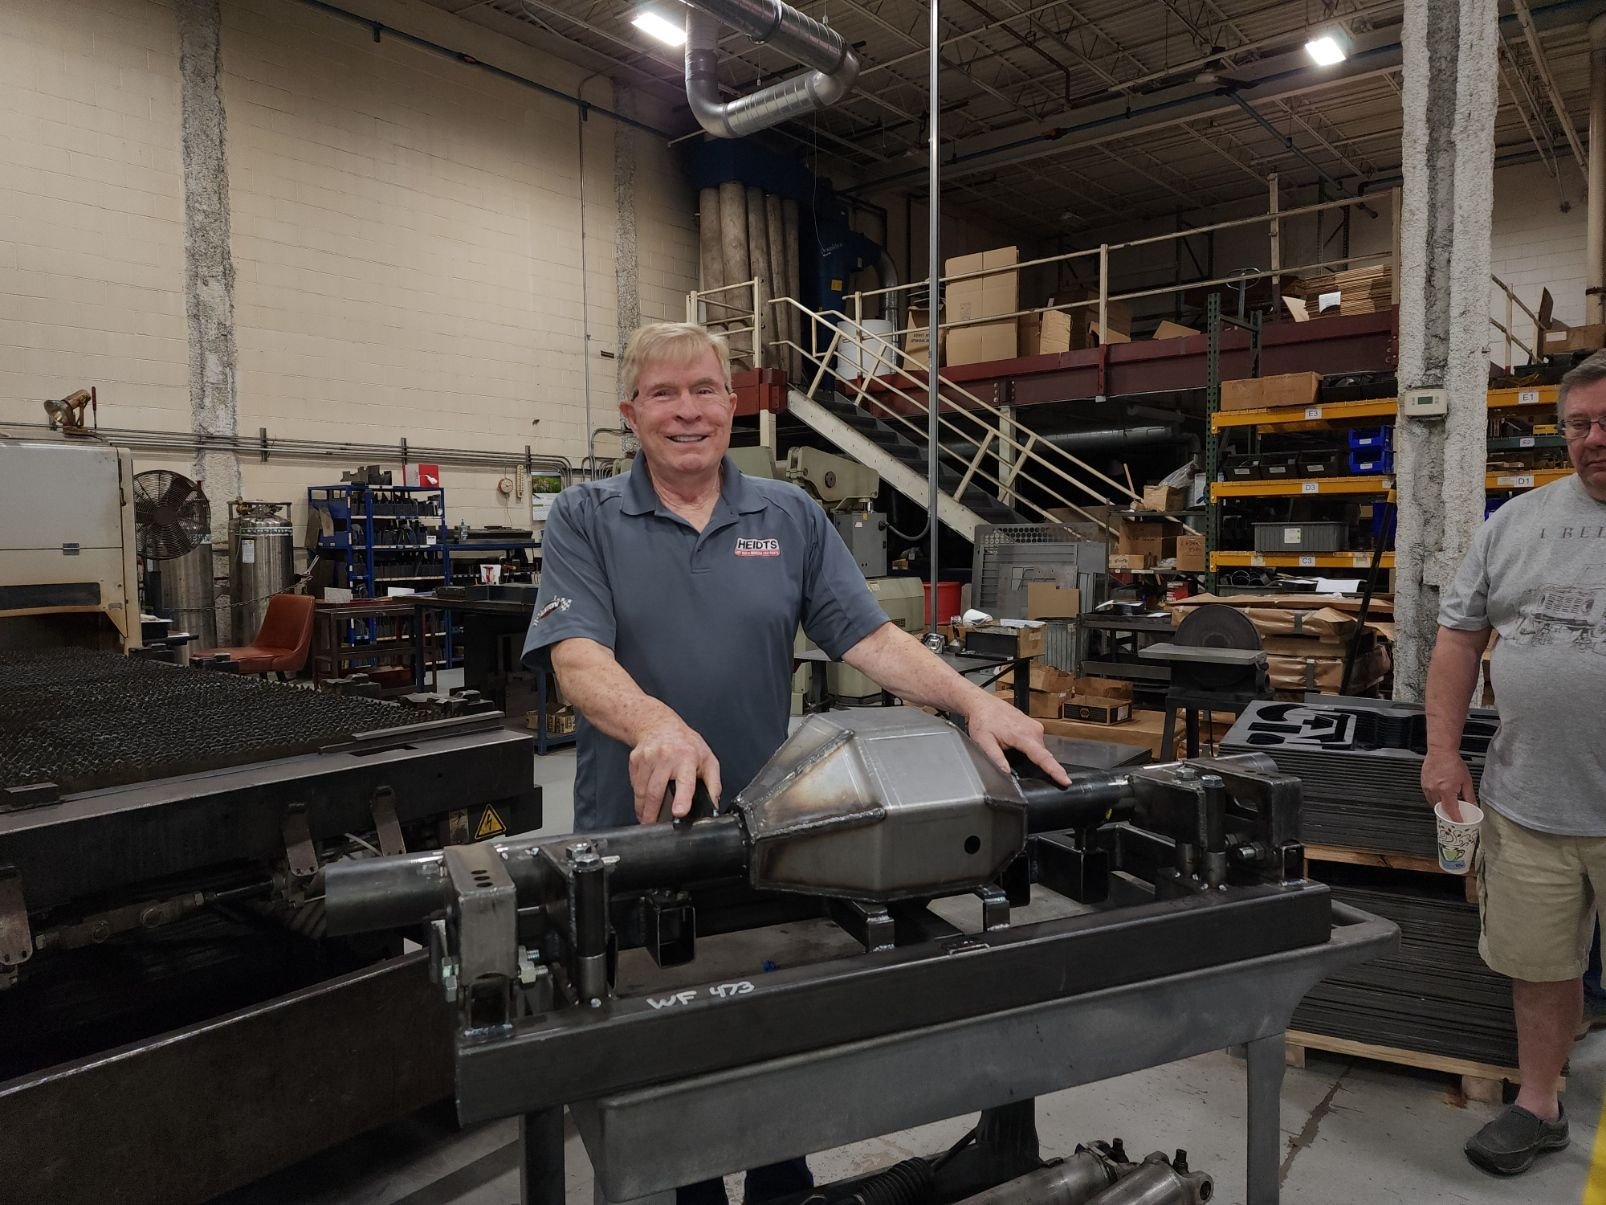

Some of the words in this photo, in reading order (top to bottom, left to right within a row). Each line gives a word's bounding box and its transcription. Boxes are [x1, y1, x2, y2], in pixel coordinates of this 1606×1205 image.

[1522, 393, 1534, 401] E1
[1308, 409, 1319, 417] E3
[1518, 477, 1530, 485] D1
[737, 539, 778, 550] HEIDTS
[646, 990, 697, 1010] WF
[709, 981, 755, 998] 473
